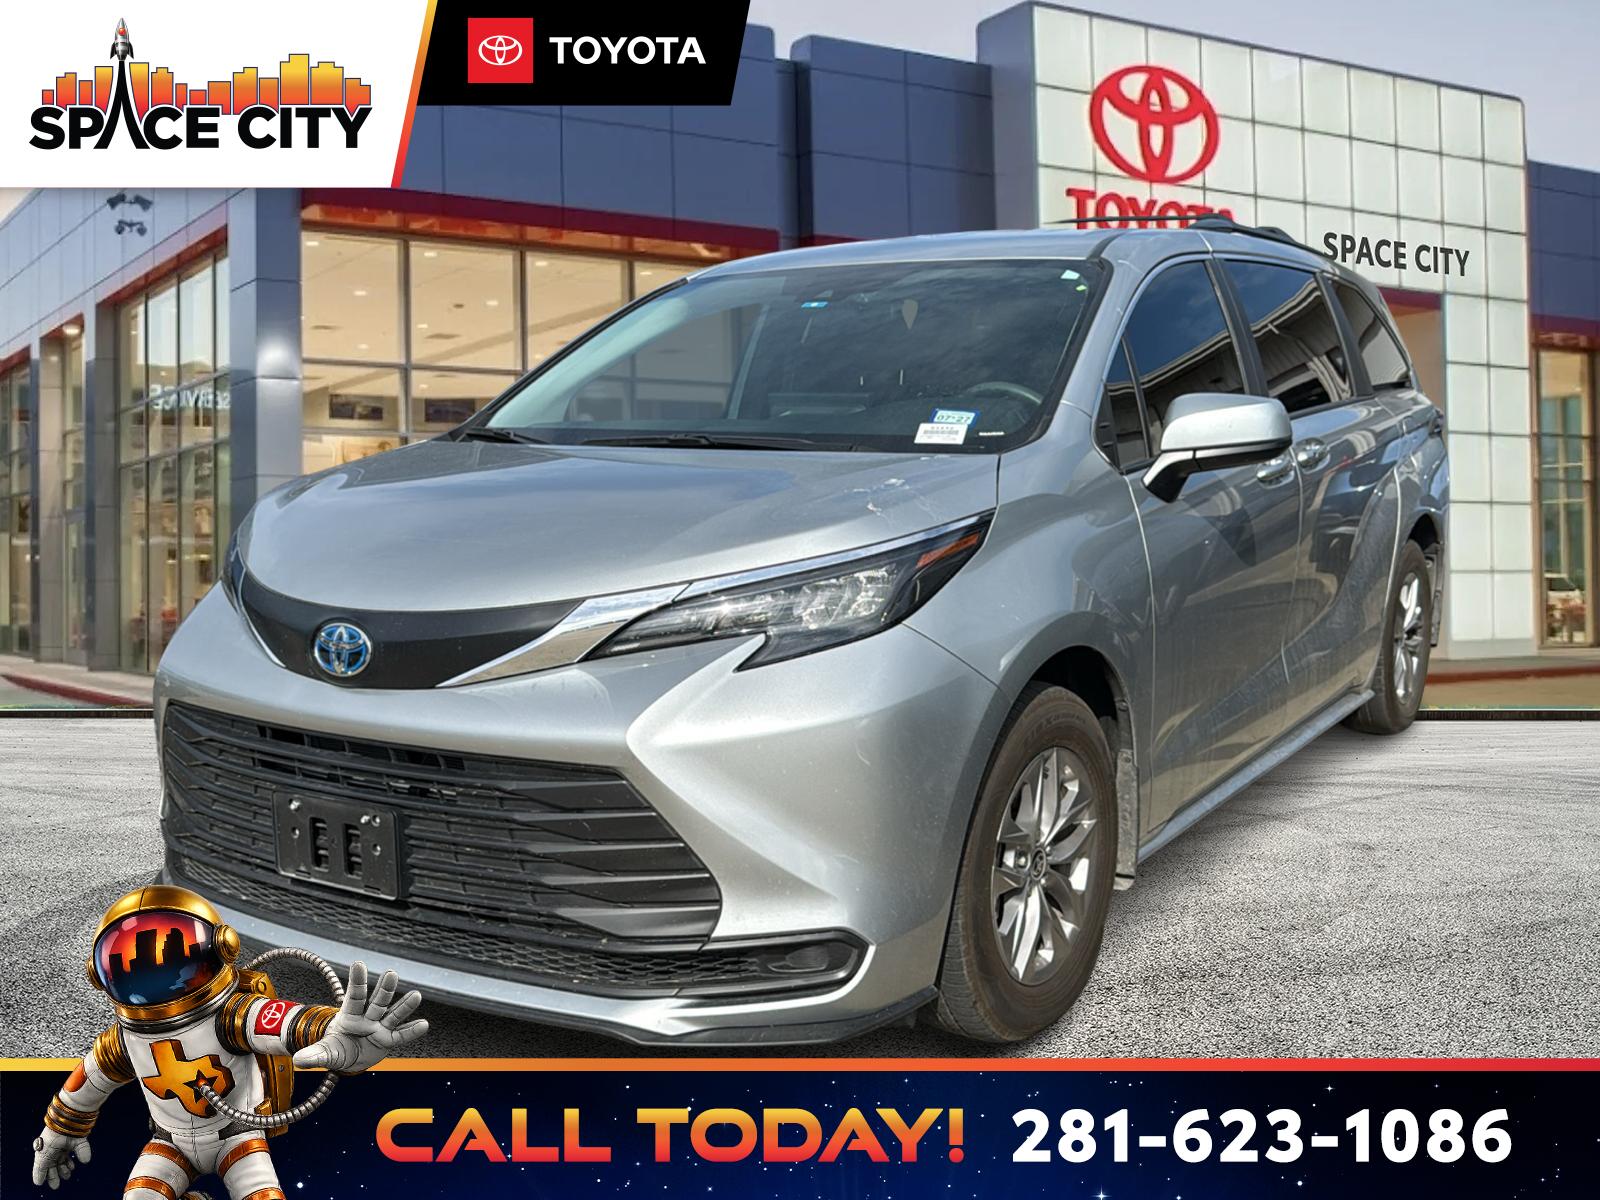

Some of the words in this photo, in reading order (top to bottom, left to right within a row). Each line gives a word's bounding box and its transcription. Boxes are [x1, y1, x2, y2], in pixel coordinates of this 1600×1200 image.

[1066, 187, 1233, 230] TOYO
[1323, 232, 1407, 270] SPACE
[1414, 244, 1470, 277] CITY
